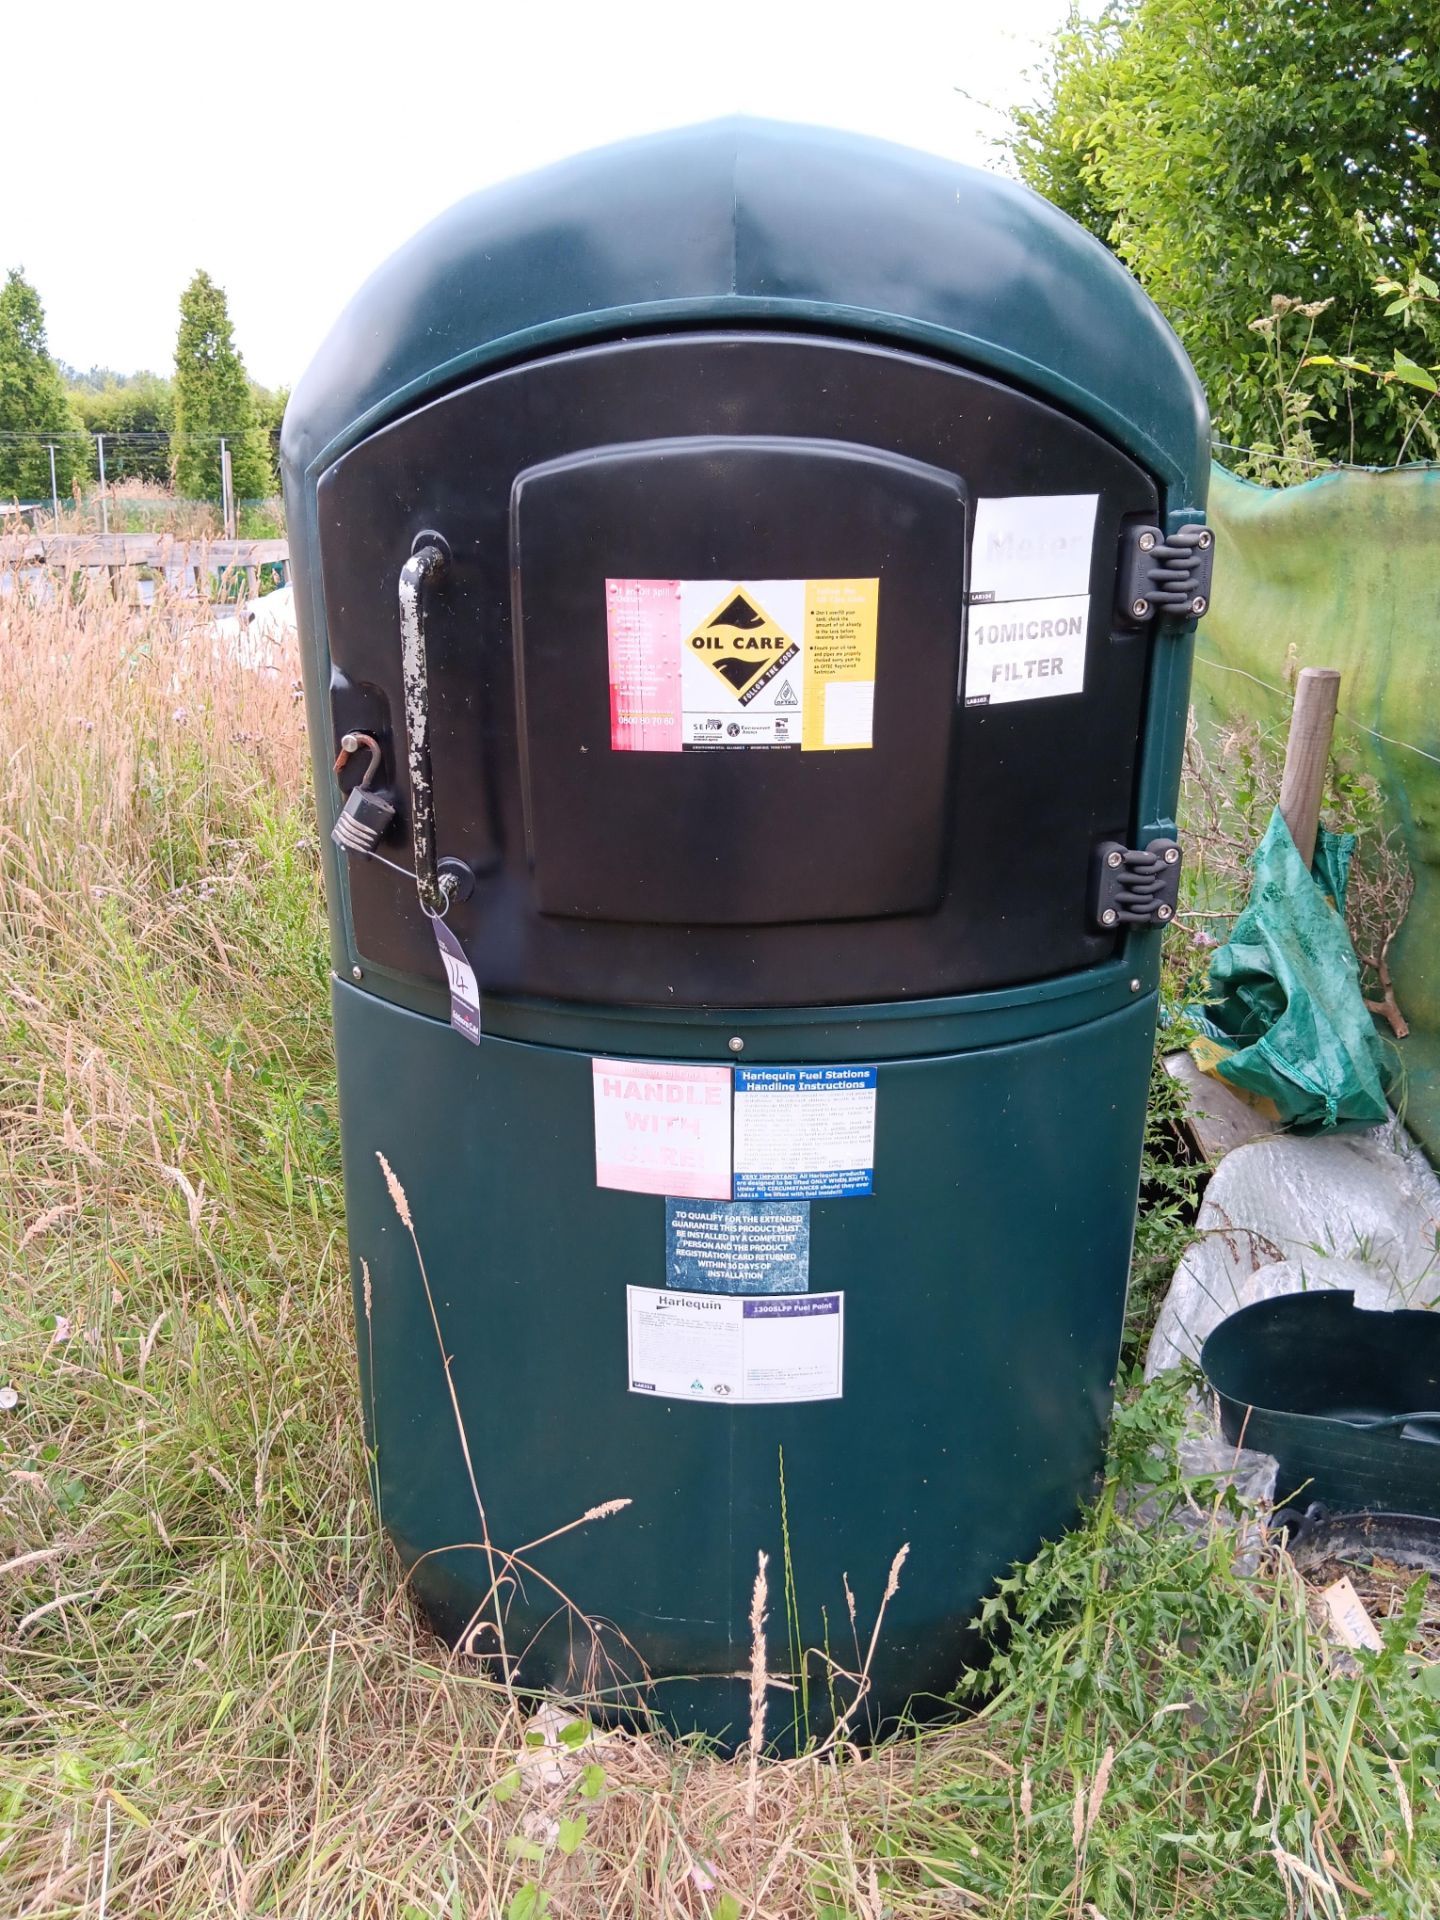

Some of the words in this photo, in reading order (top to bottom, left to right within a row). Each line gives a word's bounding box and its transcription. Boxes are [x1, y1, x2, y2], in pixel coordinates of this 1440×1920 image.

[974, 616, 1083, 646] 10MICRON
[692, 637, 724, 650] OIL
[733, 637, 785, 650] CARE
[743, 678, 765, 703] FOLLOW
[766, 665, 779, 678] THE
[779, 647, 797, 665] CODE
[991, 657, 1064, 683] FILTER
[742, 1071, 796, 1082] Harlequin
[799, 1070, 823, 1080] Fuel
[825, 1070, 871, 1080] Stations
[603, 1078, 722, 1105] HANDLE
[747, 1081, 796, 1092] Handling
[799, 1081, 866, 1091] Instructions
[839, 1170, 866, 1178] products
[747, 1179, 775, 1187] designed
[767, 1184, 819, 1192] CIRCUMSTANCES
[676, 1210, 687, 1219] TO
[688, 1212, 724, 1222] QUALIFY
[725, 1215, 742, 1223] FOR
[742, 1215, 759, 1223] THE
[759, 1215, 803, 1223] EXTENDED
[672, 1220, 719, 1231] GUARANTEE
[720, 1223, 738, 1232] THIS
[738, 1224, 778, 1233] PRODUCT
[778, 1225, 800, 1233] MUST
[676, 1229, 687, 1238] BE
[687, 1231, 729, 1241] INSTALLED
[730, 1234, 741, 1242] BY
[741, 1234, 748, 1242] A
[749, 1234, 797, 1242] COMPETENT
[683, 1240, 714, 1249] PERSON
[715, 1241, 733, 1251] AND
[733, 1243, 749, 1251] THE
[750, 1243, 789, 1251] PRODUCT
[676, 1249, 732, 1260] REGISTRATION
[732, 1253, 755, 1261] CARD
[755, 1253, 797, 1261] RETURNED
[698, 1260, 727, 1269] WITHIN
[738, 1262, 760, 1270] DAYS
[761, 1262, 773, 1270] OF
[707, 1270, 764, 1280] INSTALLATION
[659, 1295, 722, 1311] Harlequin
[794, 1304, 811, 1312] Fuel
[812, 1302, 833, 1310] Point
